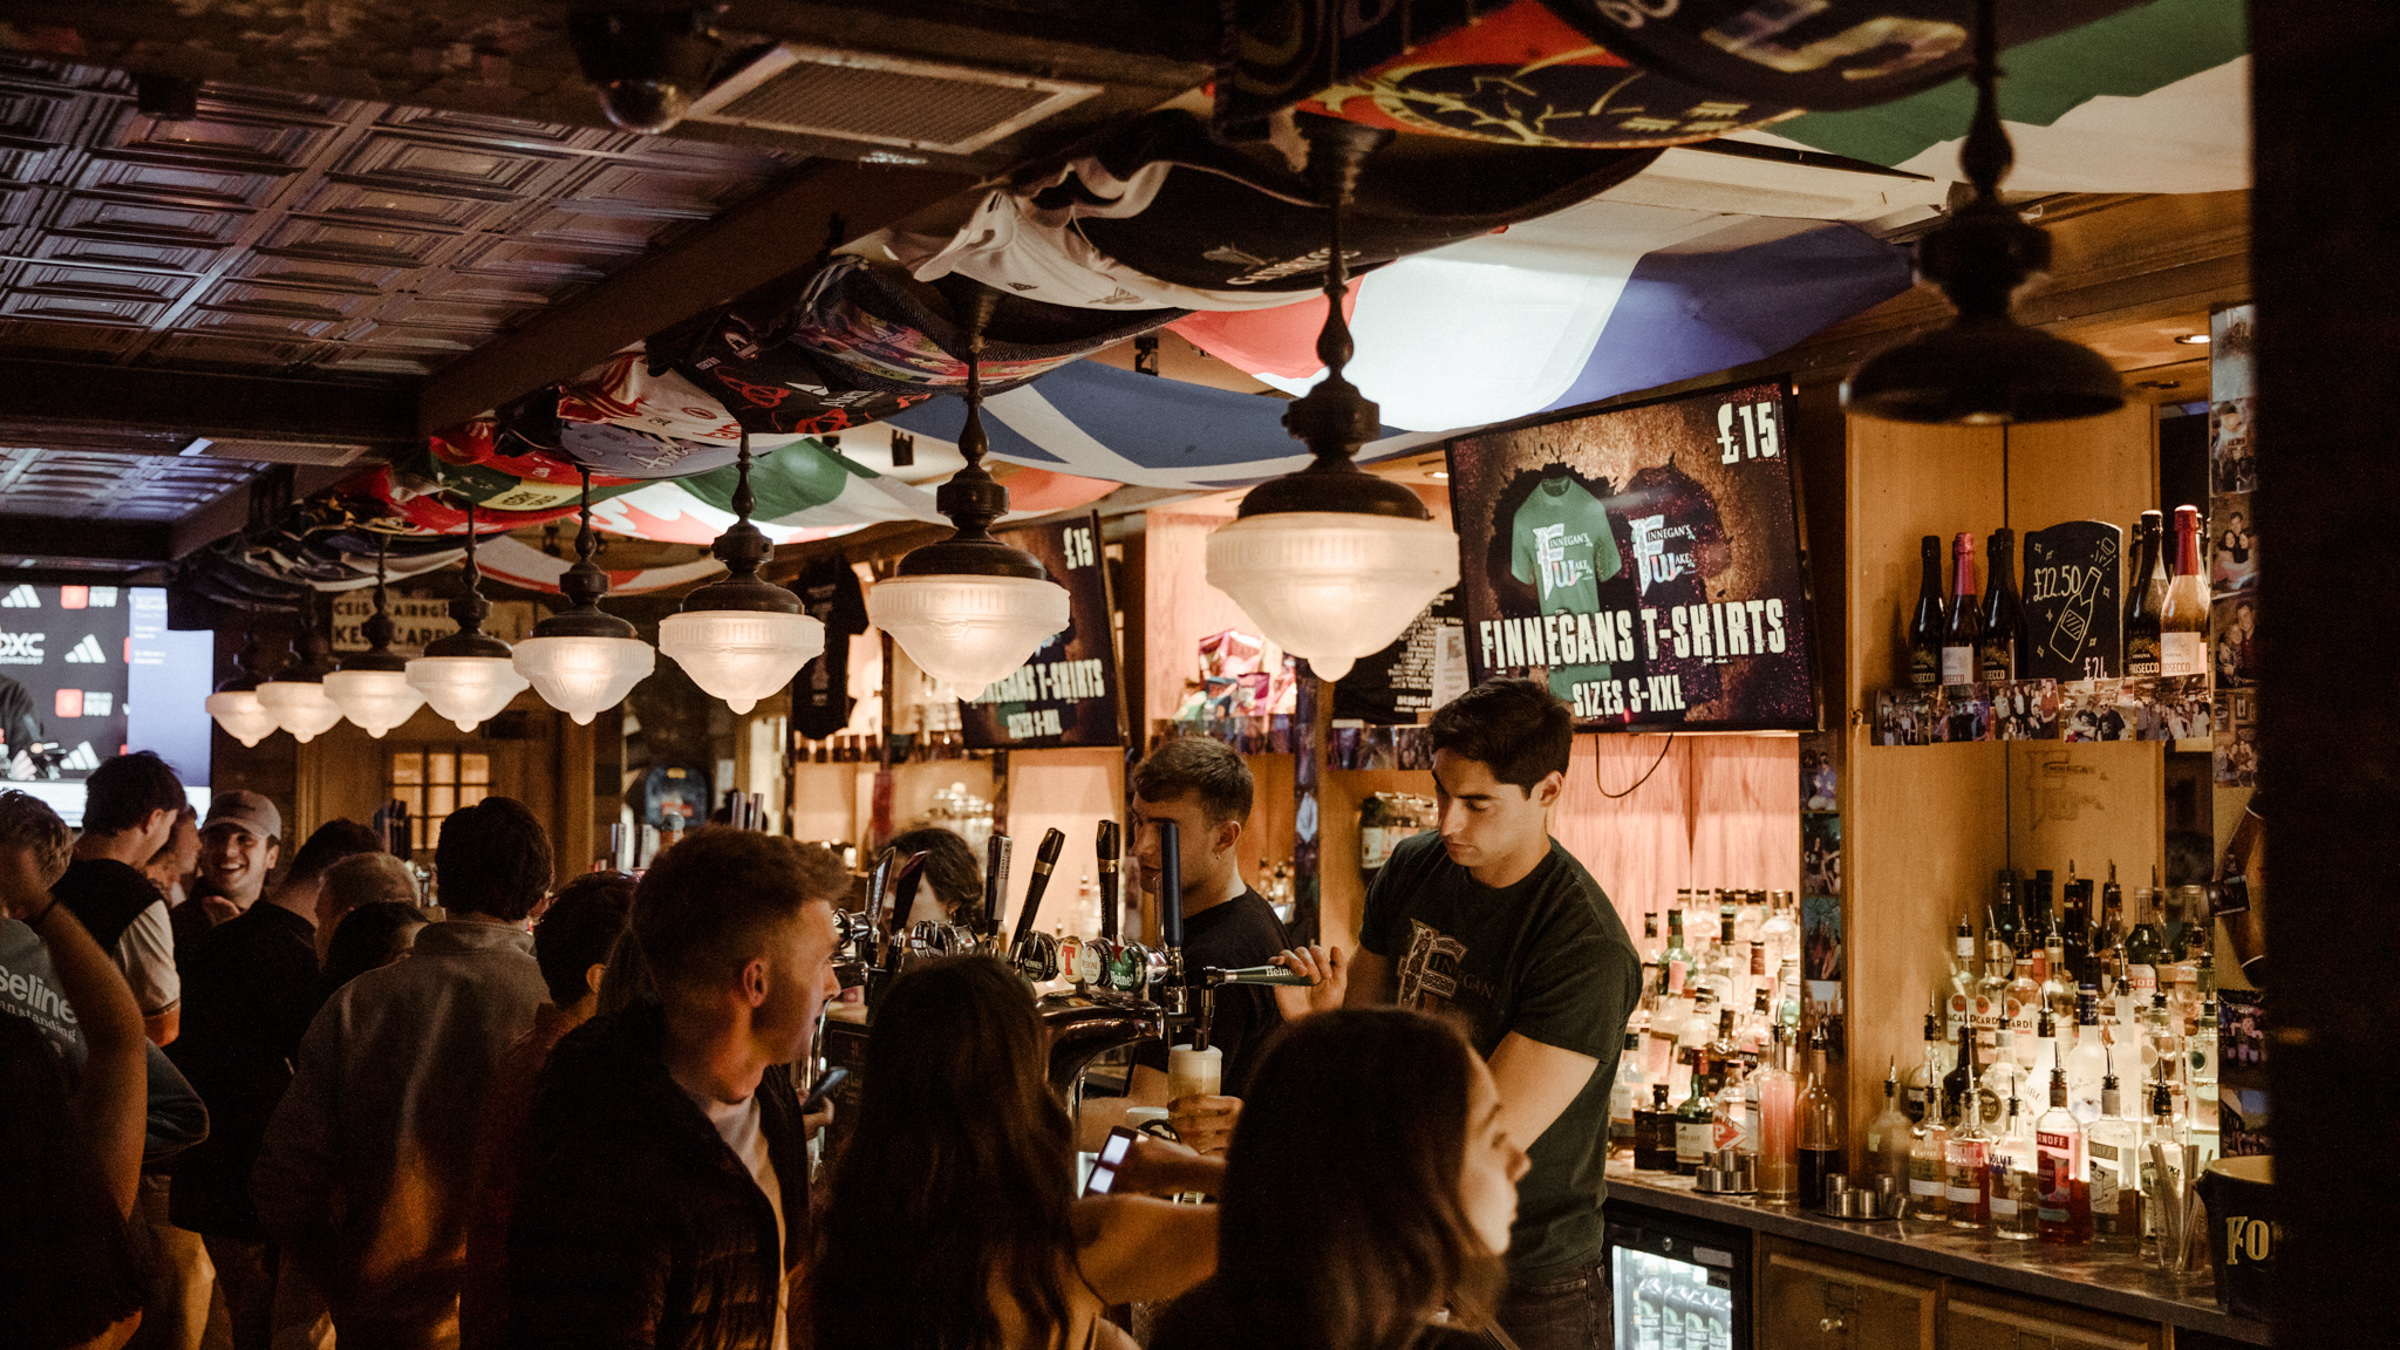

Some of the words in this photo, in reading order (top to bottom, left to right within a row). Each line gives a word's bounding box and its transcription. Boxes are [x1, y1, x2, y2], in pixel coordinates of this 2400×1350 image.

[1717, 401, 1779, 465] £15
[1063, 527, 1095, 570] £15
[1480, 609, 1635, 669] FINNEGANS
[1641, 599, 1787, 660] T-SHIRTS
[1573, 682, 1625, 717] SIZES
[1629, 675, 1686, 714] S-XXL
